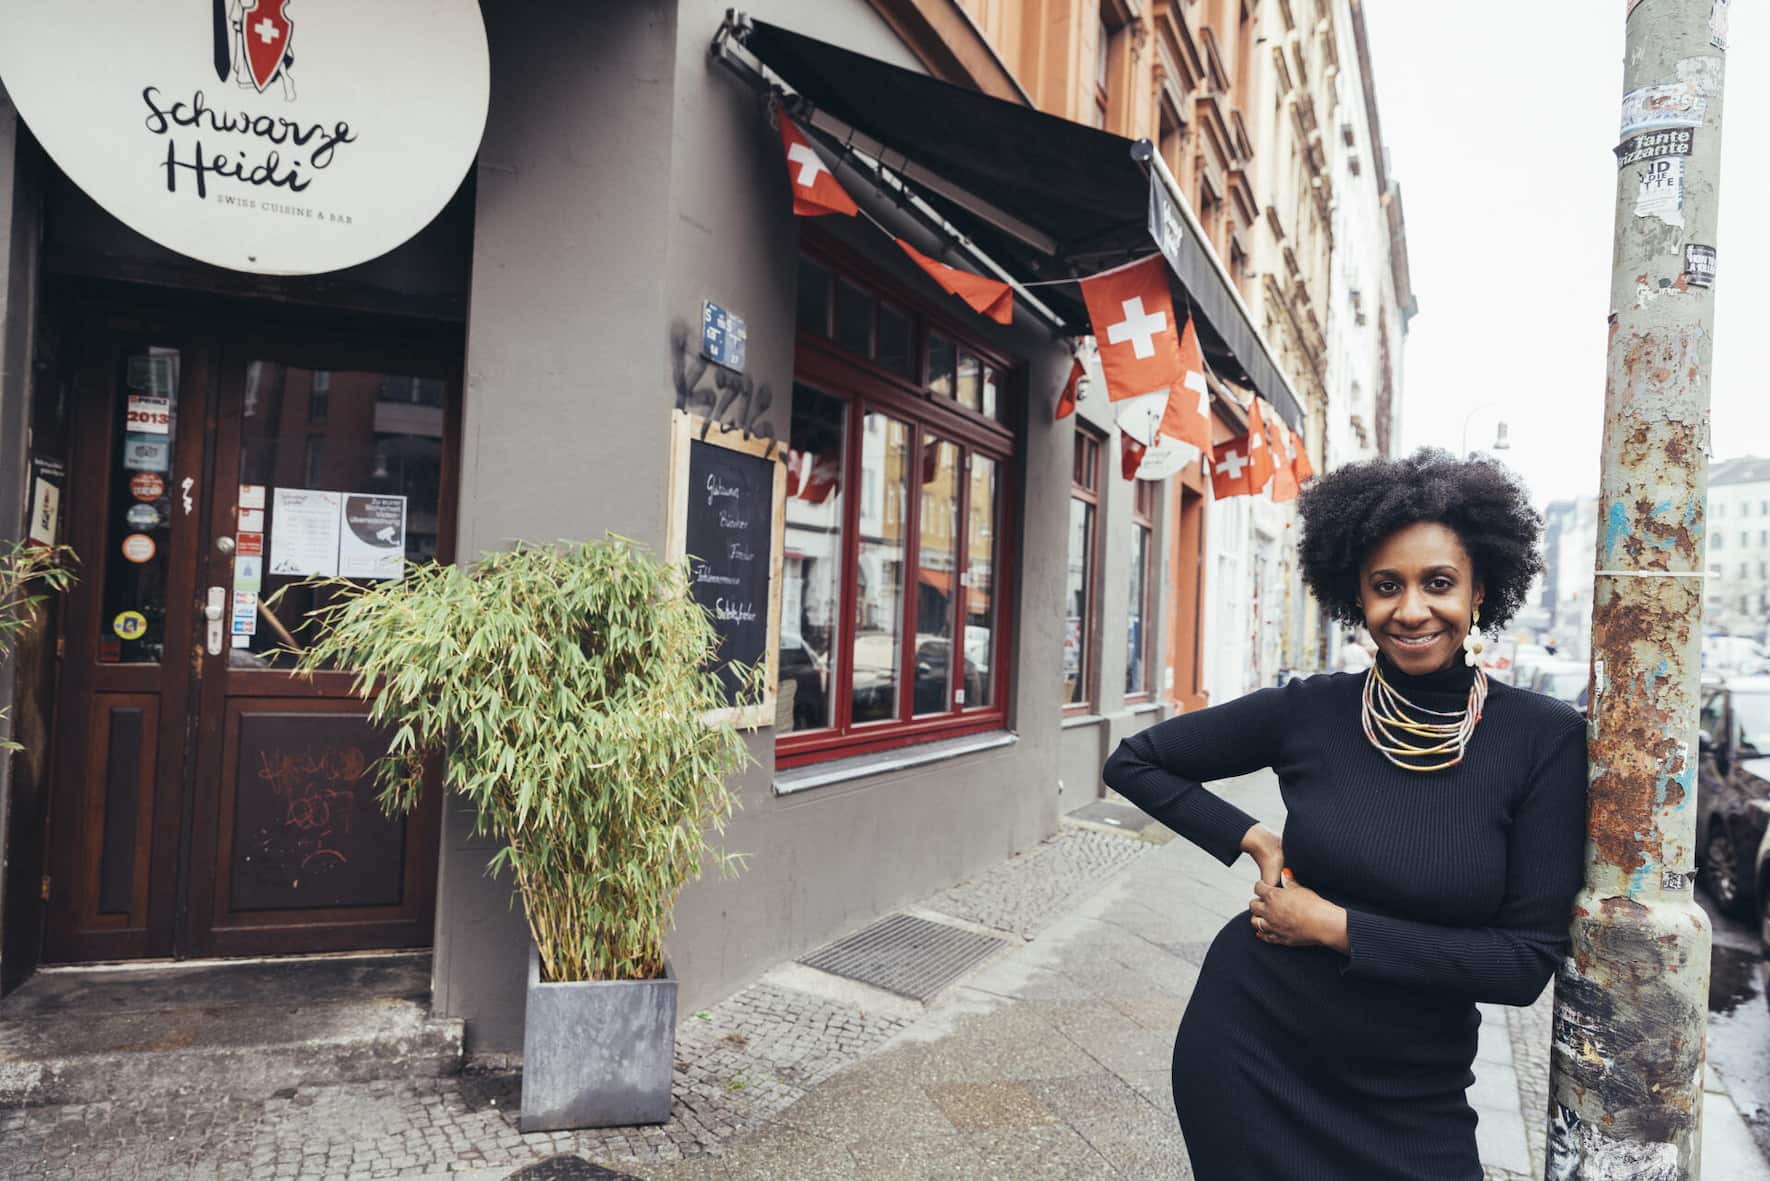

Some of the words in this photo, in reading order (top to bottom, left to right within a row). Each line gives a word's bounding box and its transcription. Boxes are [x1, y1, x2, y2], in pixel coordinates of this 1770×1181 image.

[142, 86, 358, 169] Schwarze
[161, 139, 313, 199] Heidi
[217, 194, 256, 208] SWISS
[261, 202, 313, 218] CUISINE
[330, 213, 353, 225] BAR
[127, 411, 169, 425] 2013
